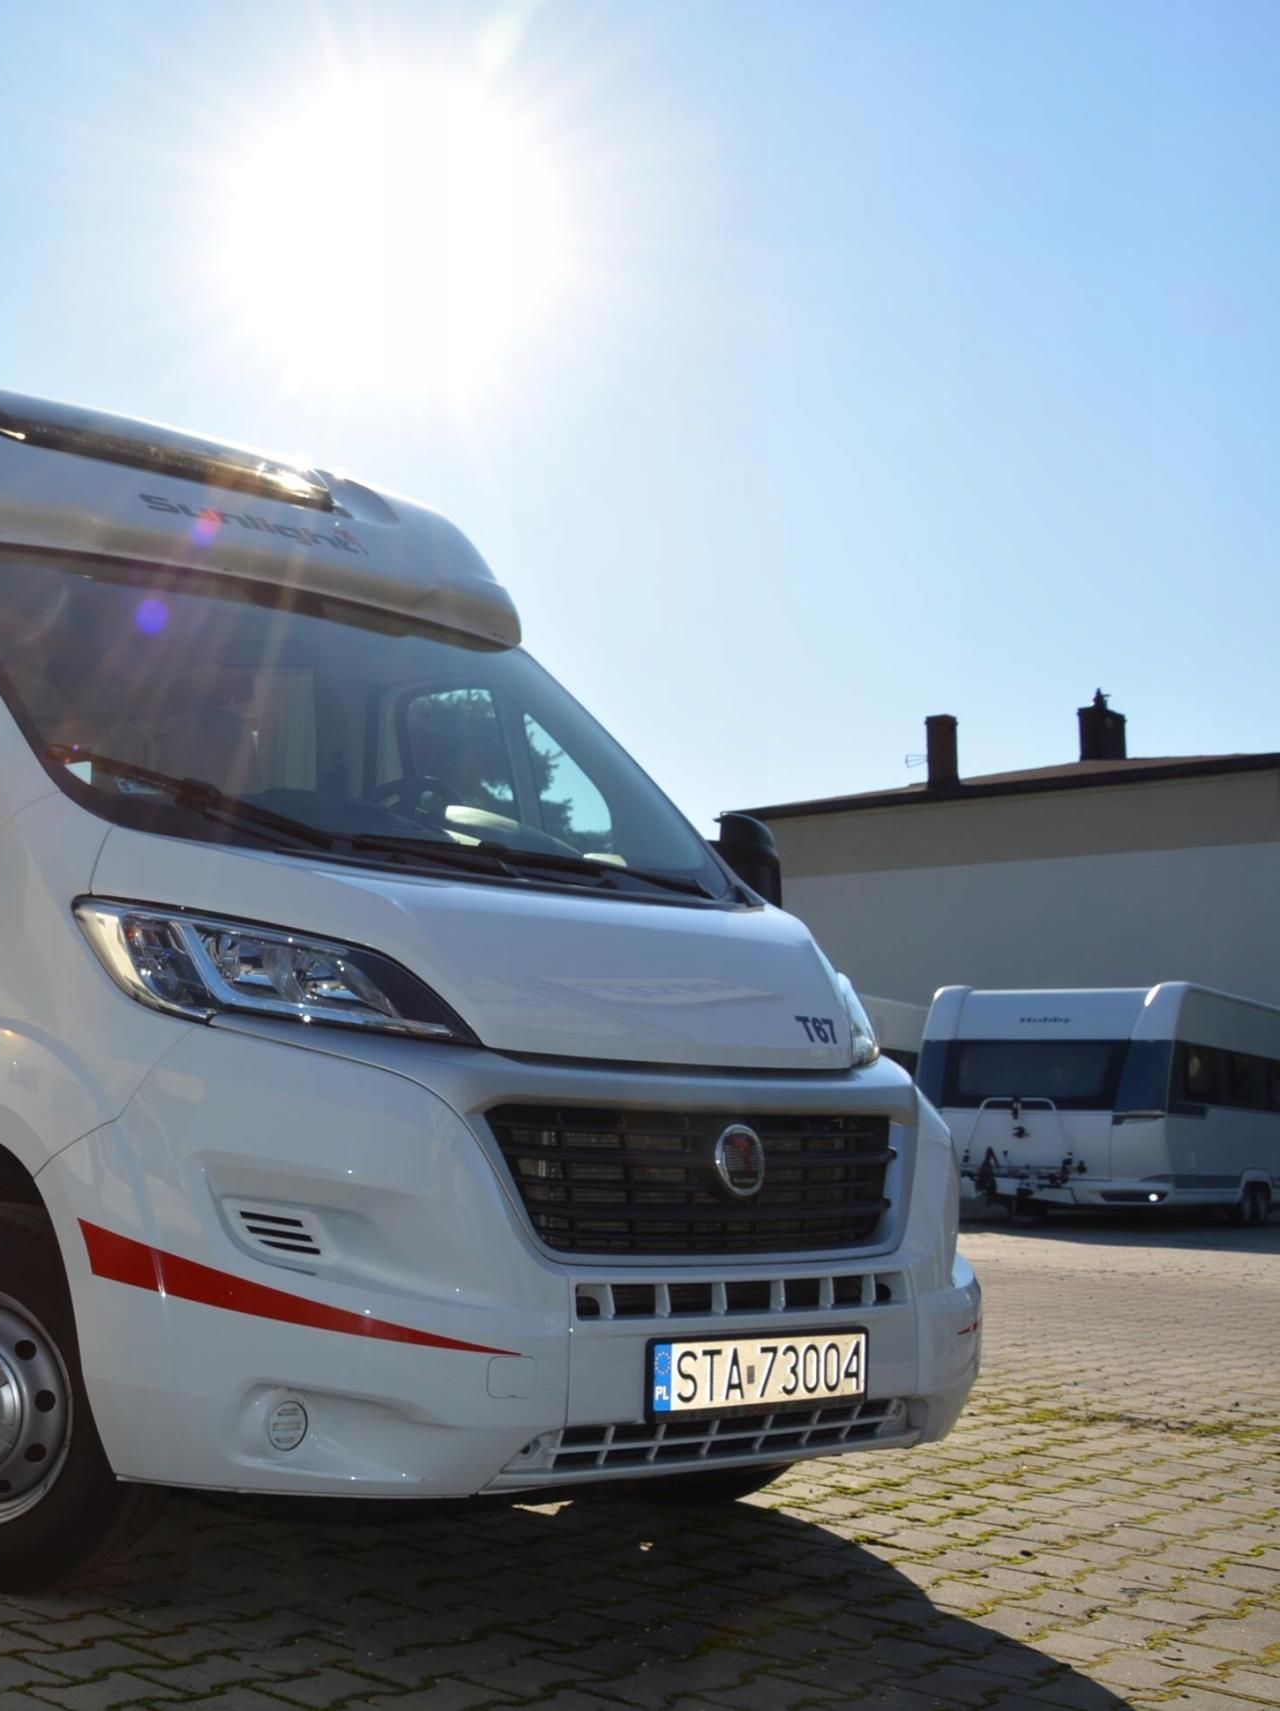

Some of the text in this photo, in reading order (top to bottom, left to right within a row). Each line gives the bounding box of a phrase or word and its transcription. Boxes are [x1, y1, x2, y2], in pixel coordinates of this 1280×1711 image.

[794, 1015, 838, 1045] T67
[676, 1340, 862, 1403] STA 73004
[654, 1385, 670, 1402] PL
